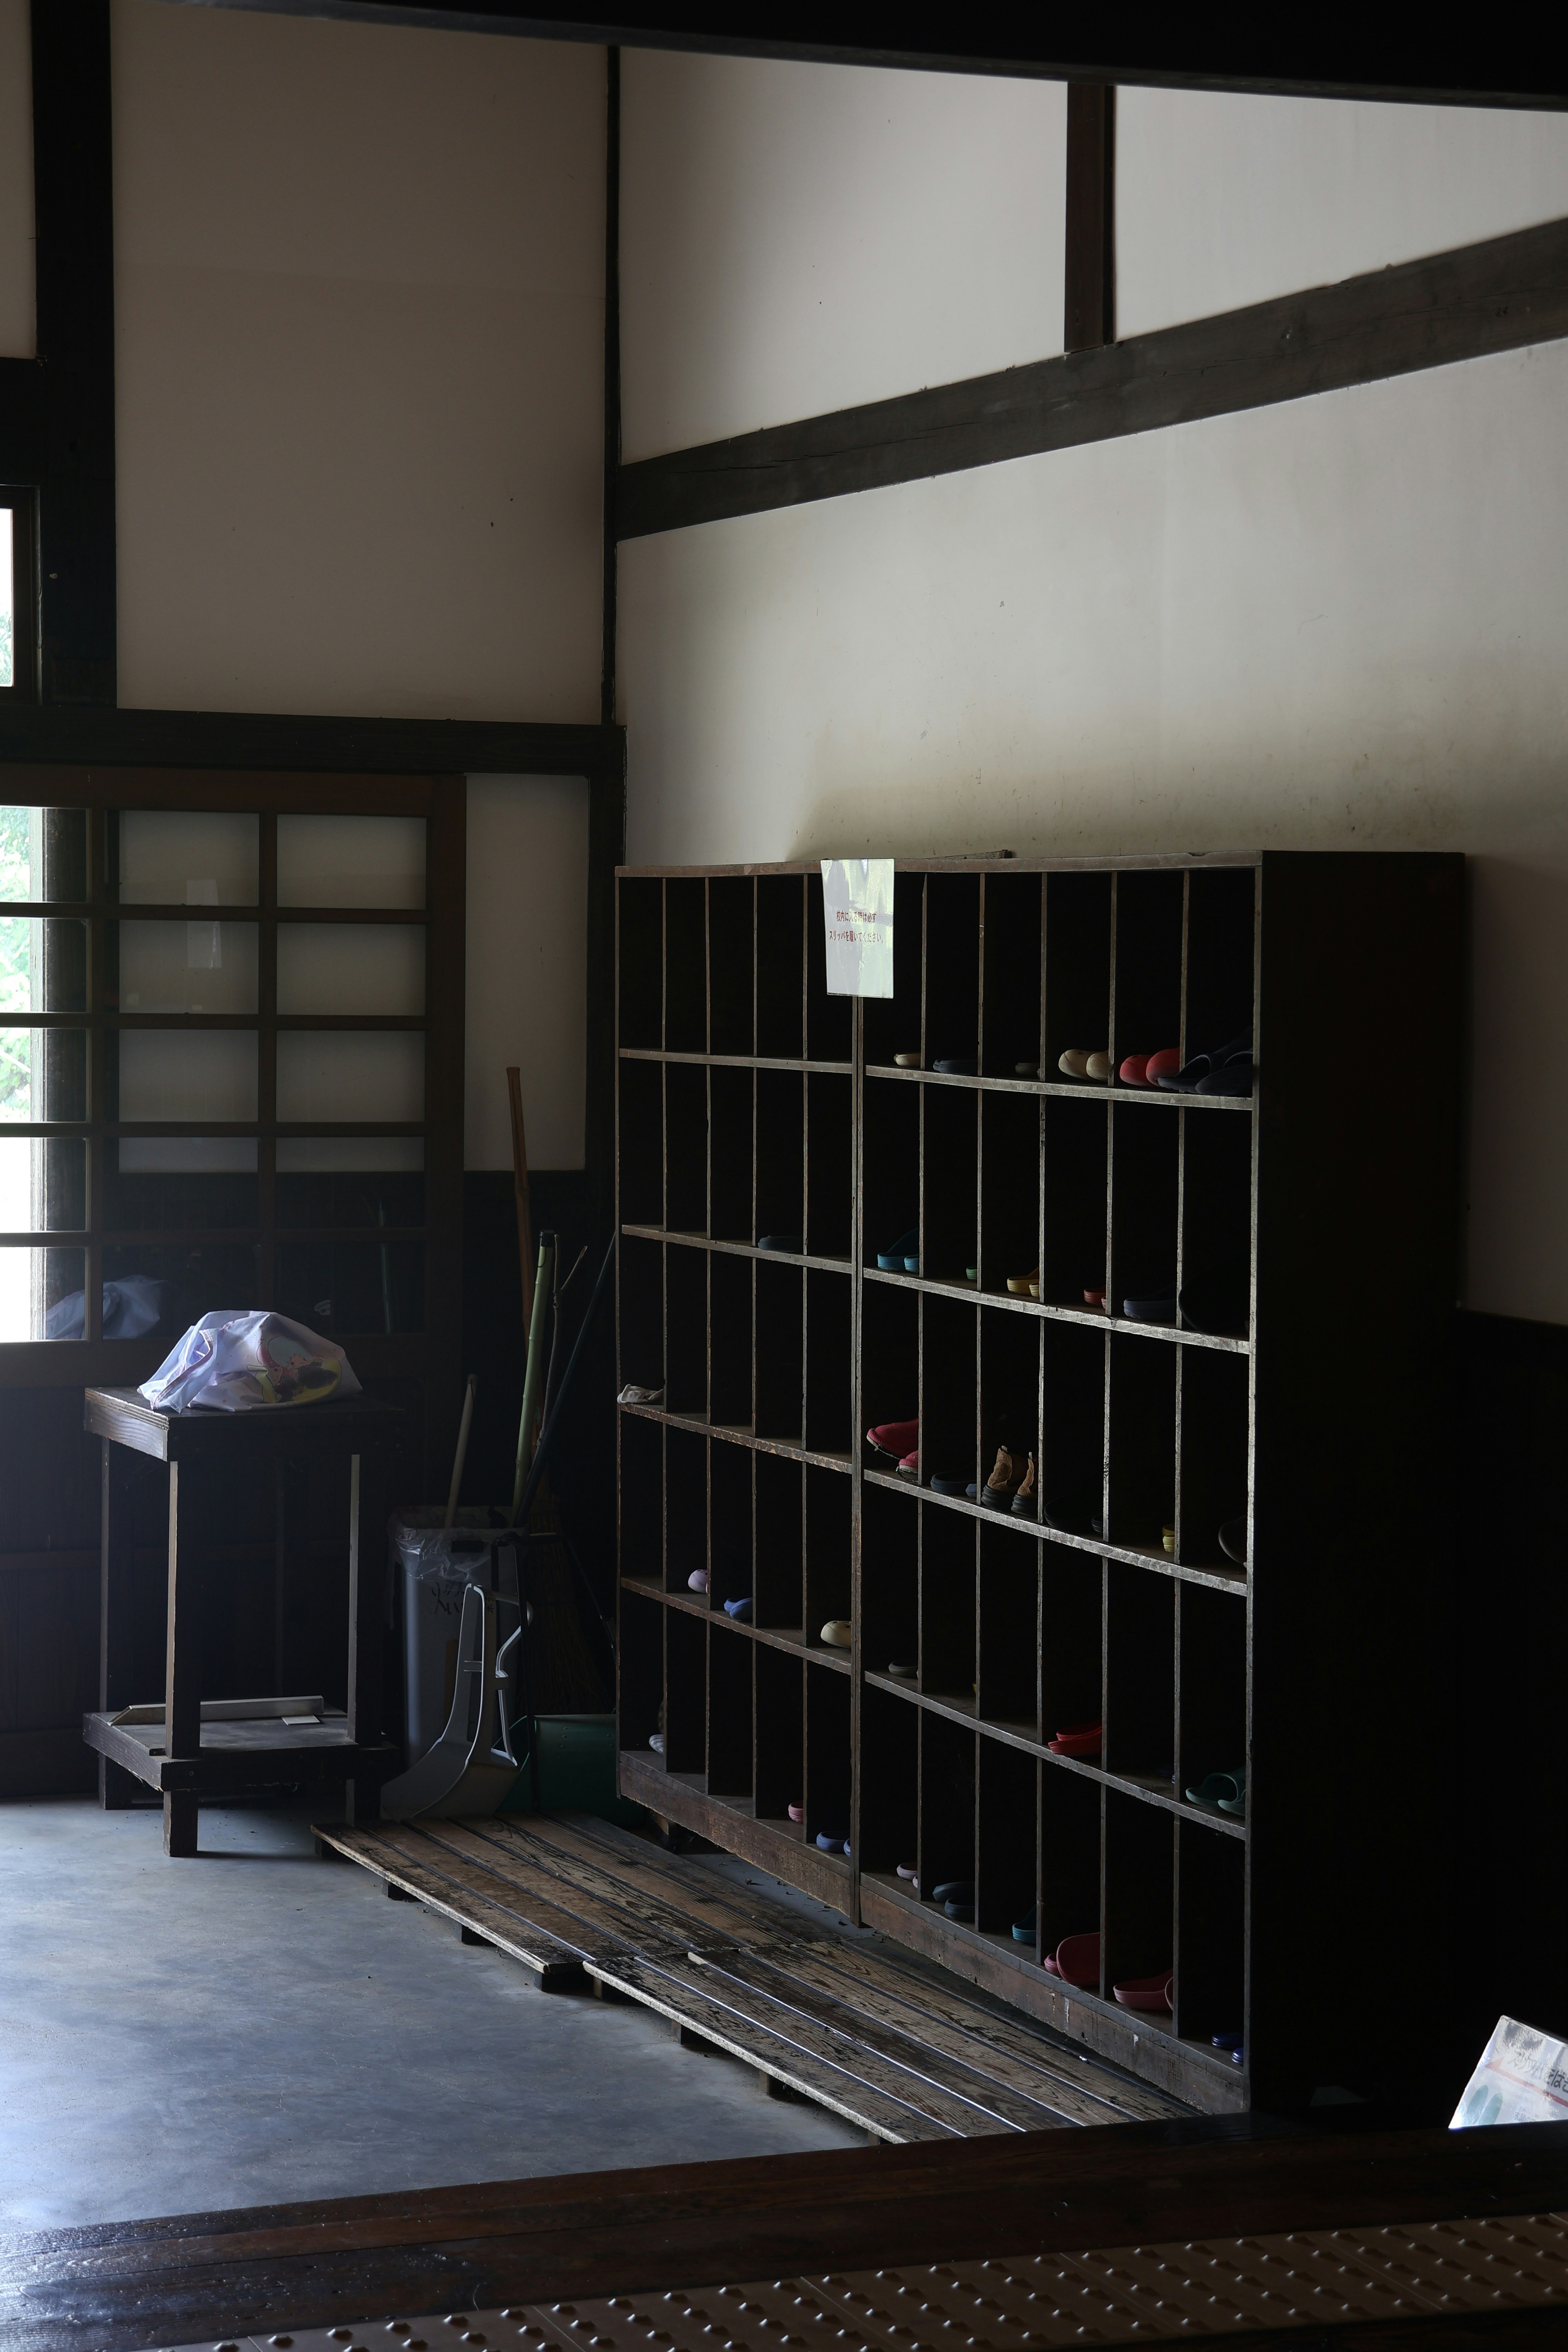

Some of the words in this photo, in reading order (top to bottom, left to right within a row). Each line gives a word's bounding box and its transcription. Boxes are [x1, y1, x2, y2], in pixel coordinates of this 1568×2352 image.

[836, 910, 877, 923] 校内に入る時は必ず
[829, 930, 884, 944] スリッパを履いてください。
